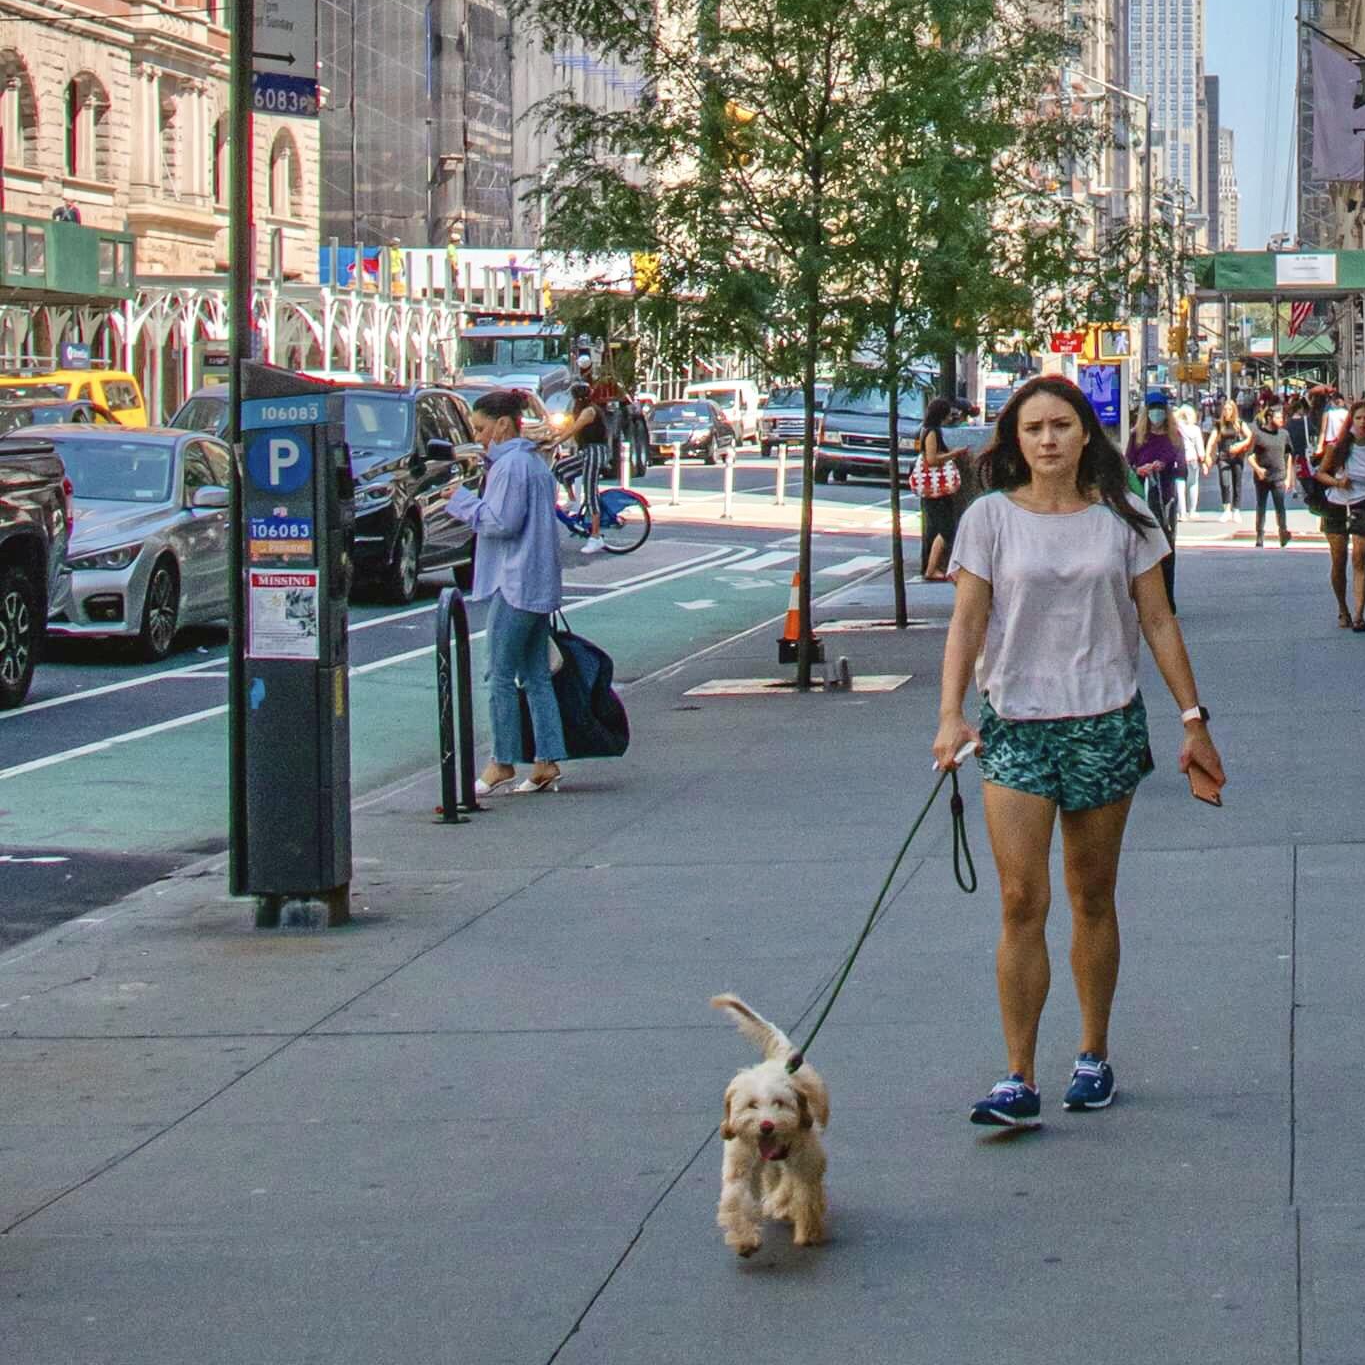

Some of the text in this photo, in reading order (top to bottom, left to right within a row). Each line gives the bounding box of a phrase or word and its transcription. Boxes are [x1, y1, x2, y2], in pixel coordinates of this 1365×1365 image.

[253, 87, 308, 112] 6083P
[262, 406, 318, 421] 106083
[269, 438, 300, 485] P
[252, 524, 309, 538] 106083
[257, 576, 311, 586] MISSING
